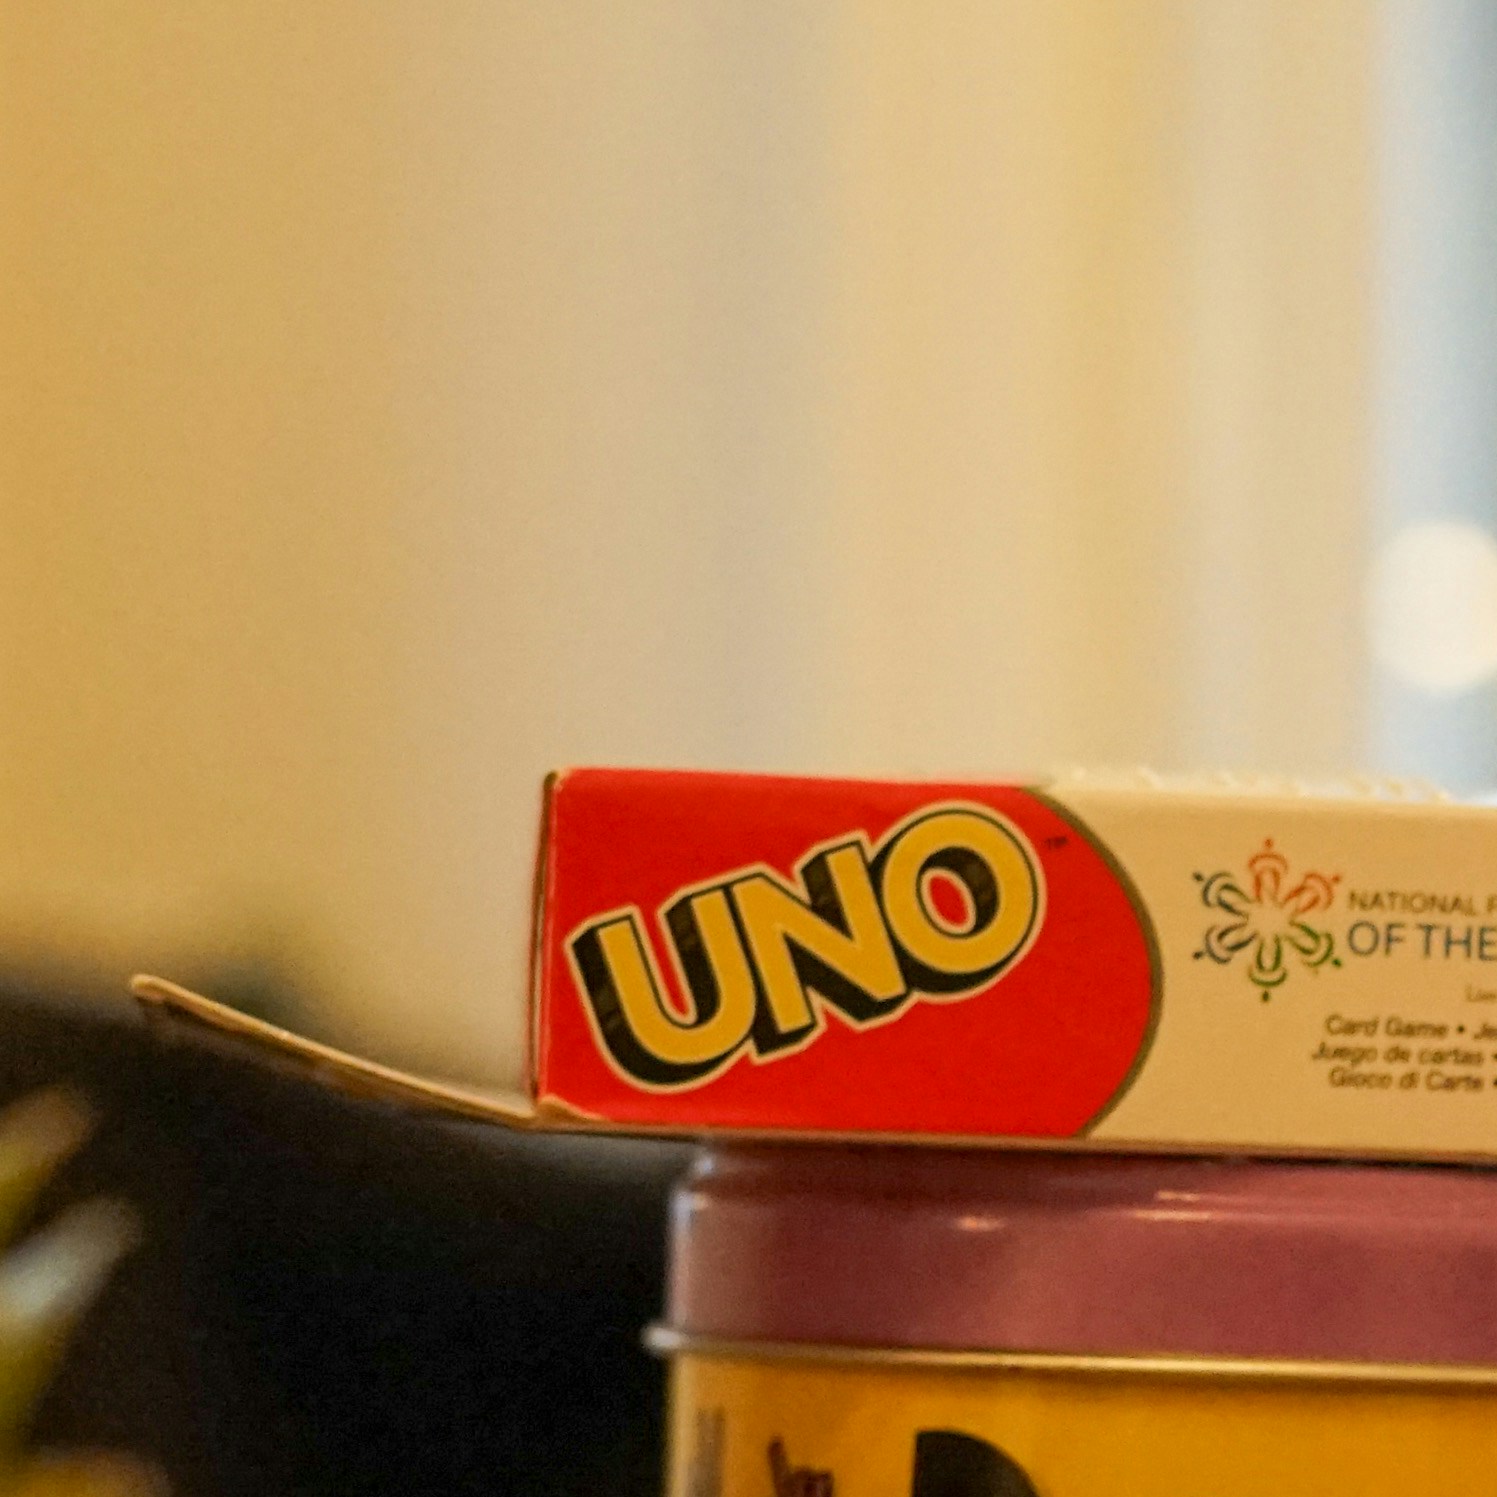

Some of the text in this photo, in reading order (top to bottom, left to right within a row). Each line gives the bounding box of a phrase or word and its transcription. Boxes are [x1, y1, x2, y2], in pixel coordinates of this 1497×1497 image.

[1350, 890, 1476, 917] NATIONAL
[570, 804, 1044, 1089] UNO
[1347, 919, 1405, 957] OF
[1324, 1013, 1379, 1037] Card
[1384, 1015, 1449, 1040] Game
[1311, 1042, 1378, 1067] Juego
[1383, 1047, 1411, 1064] de
[1328, 1066, 1394, 1090] Gioco
